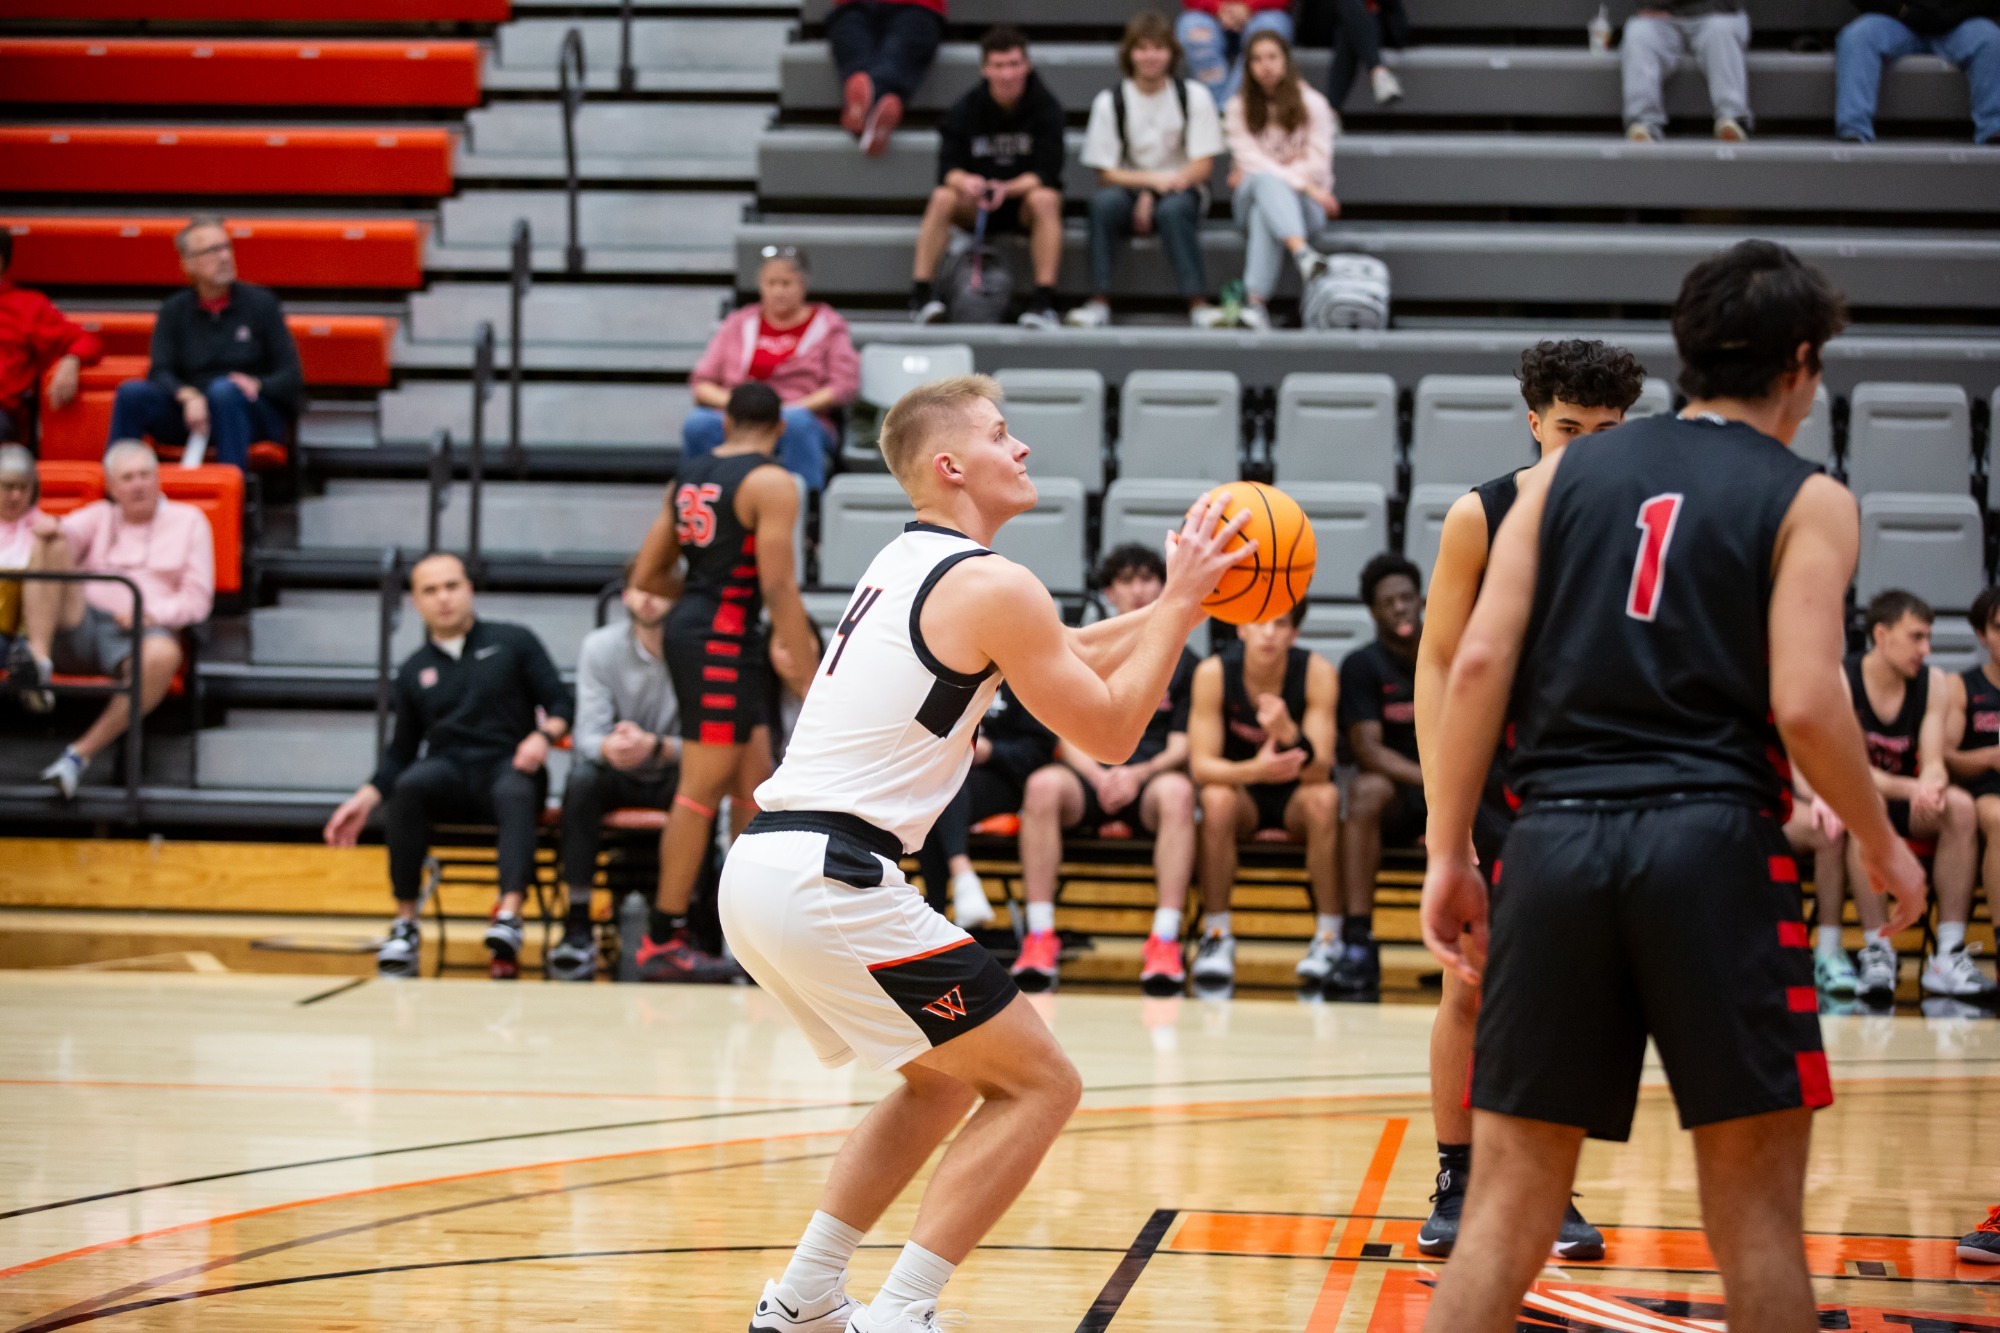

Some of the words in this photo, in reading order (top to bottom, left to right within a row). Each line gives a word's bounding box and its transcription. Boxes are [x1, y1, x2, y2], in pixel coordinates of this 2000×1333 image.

[676, 483, 722, 548] 35
[1626, 492, 1684, 622] 1
[826, 585, 884, 677] 4
[921, 984, 967, 1021] W
